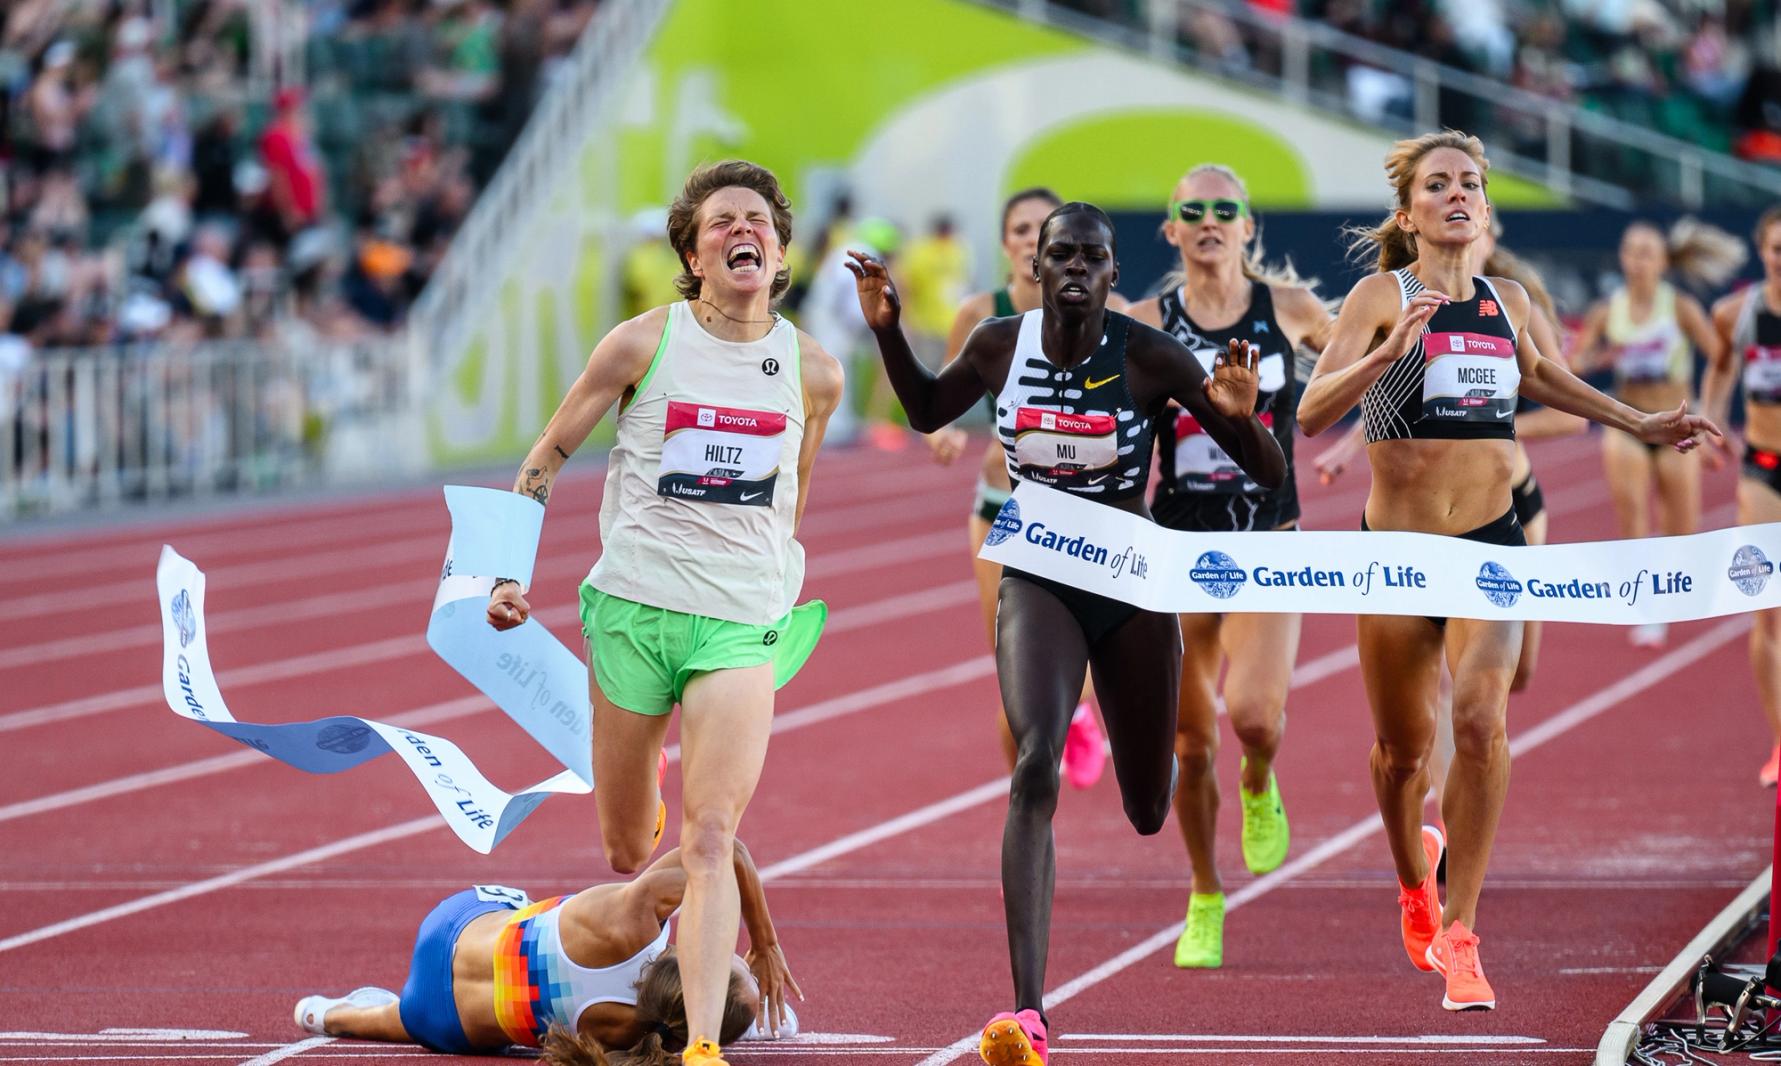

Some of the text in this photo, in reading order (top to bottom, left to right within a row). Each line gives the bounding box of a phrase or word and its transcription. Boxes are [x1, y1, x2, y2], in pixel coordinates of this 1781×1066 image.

[1466, 340, 1496, 350] TOYOTA
[1458, 367, 1496, 385] MCGEE
[718, 415, 757, 427] TOYOTA
[1058, 418, 1092, 430] TOYOTA
[704, 444, 743, 465] HILTZ
[1056, 443, 1076, 460] MU
[681, 487, 706, 496] USATF
[1025, 522, 1148, 580] Garden of Life
[1191, 570, 1244, 581] Garden of Life
[1252, 561, 1427, 596] Garden of Life
[1729, 568, 1751, 578] Garden
[1758, 564, 1771, 574] Life
[1478, 580, 1500, 590] Garden
[1506, 582, 1520, 591] Life
[1527, 569, 1693, 606] Garden of Life
[177, 653, 207, 721] Garde
[434, 773, 471, 797] of
[456, 800, 494, 829] Life
